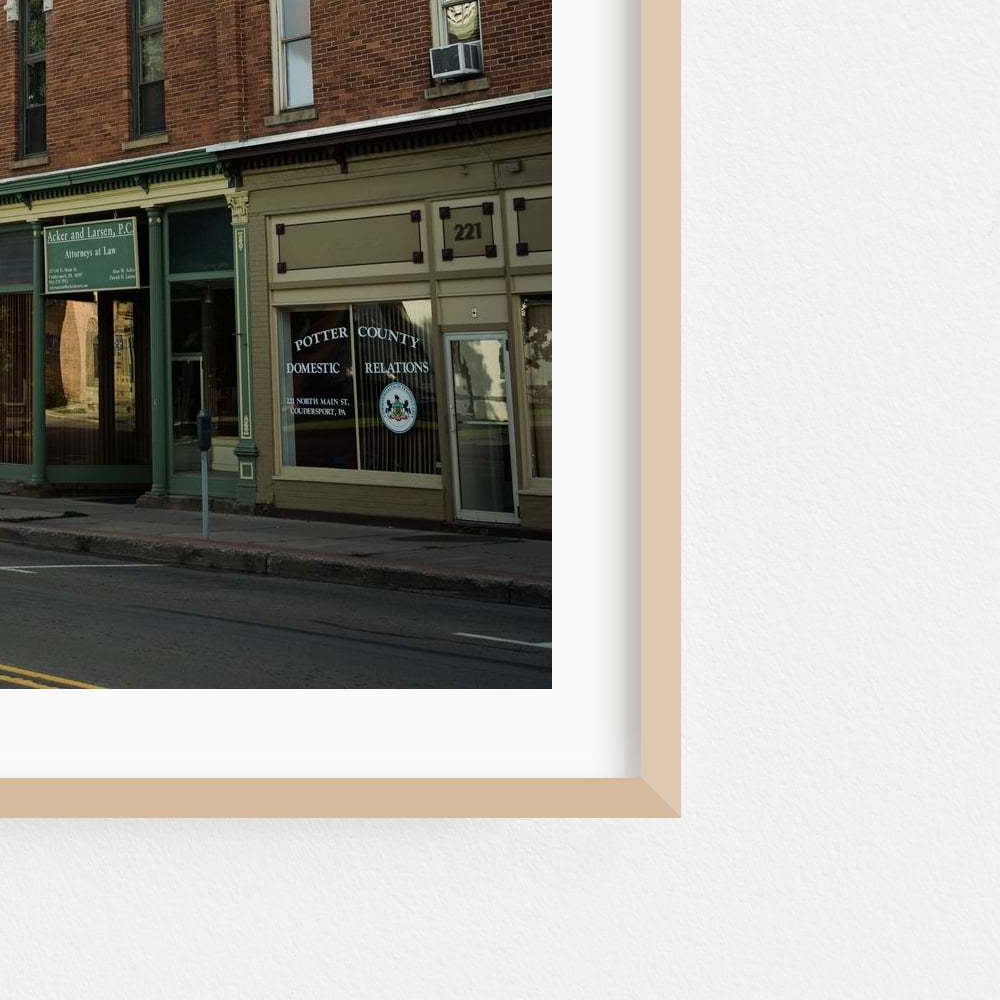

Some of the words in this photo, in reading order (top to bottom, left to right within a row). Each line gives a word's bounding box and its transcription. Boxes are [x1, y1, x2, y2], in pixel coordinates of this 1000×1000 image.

[47, 229, 68, 242] Acker
[70, 226, 85, 240] and
[87, 225, 116, 237] Larsen,
[454, 222, 481, 241] 221
[65, 249, 93, 259] Attorneys
[94, 248, 101, 256] at
[103, 246, 116, 256] Law
[294, 326, 349, 352] POTTER
[357, 325, 420, 350] COUNTY
[286, 362, 340, 374] DOMESTIC
[364, 361, 430, 374] RELATIONS
[296, 397, 319, 406] NORTH
[320, 398, 340, 406] MAIN
[340, 398, 351, 406] ST.
[290, 408, 337, 417] COUDERSPORT,
